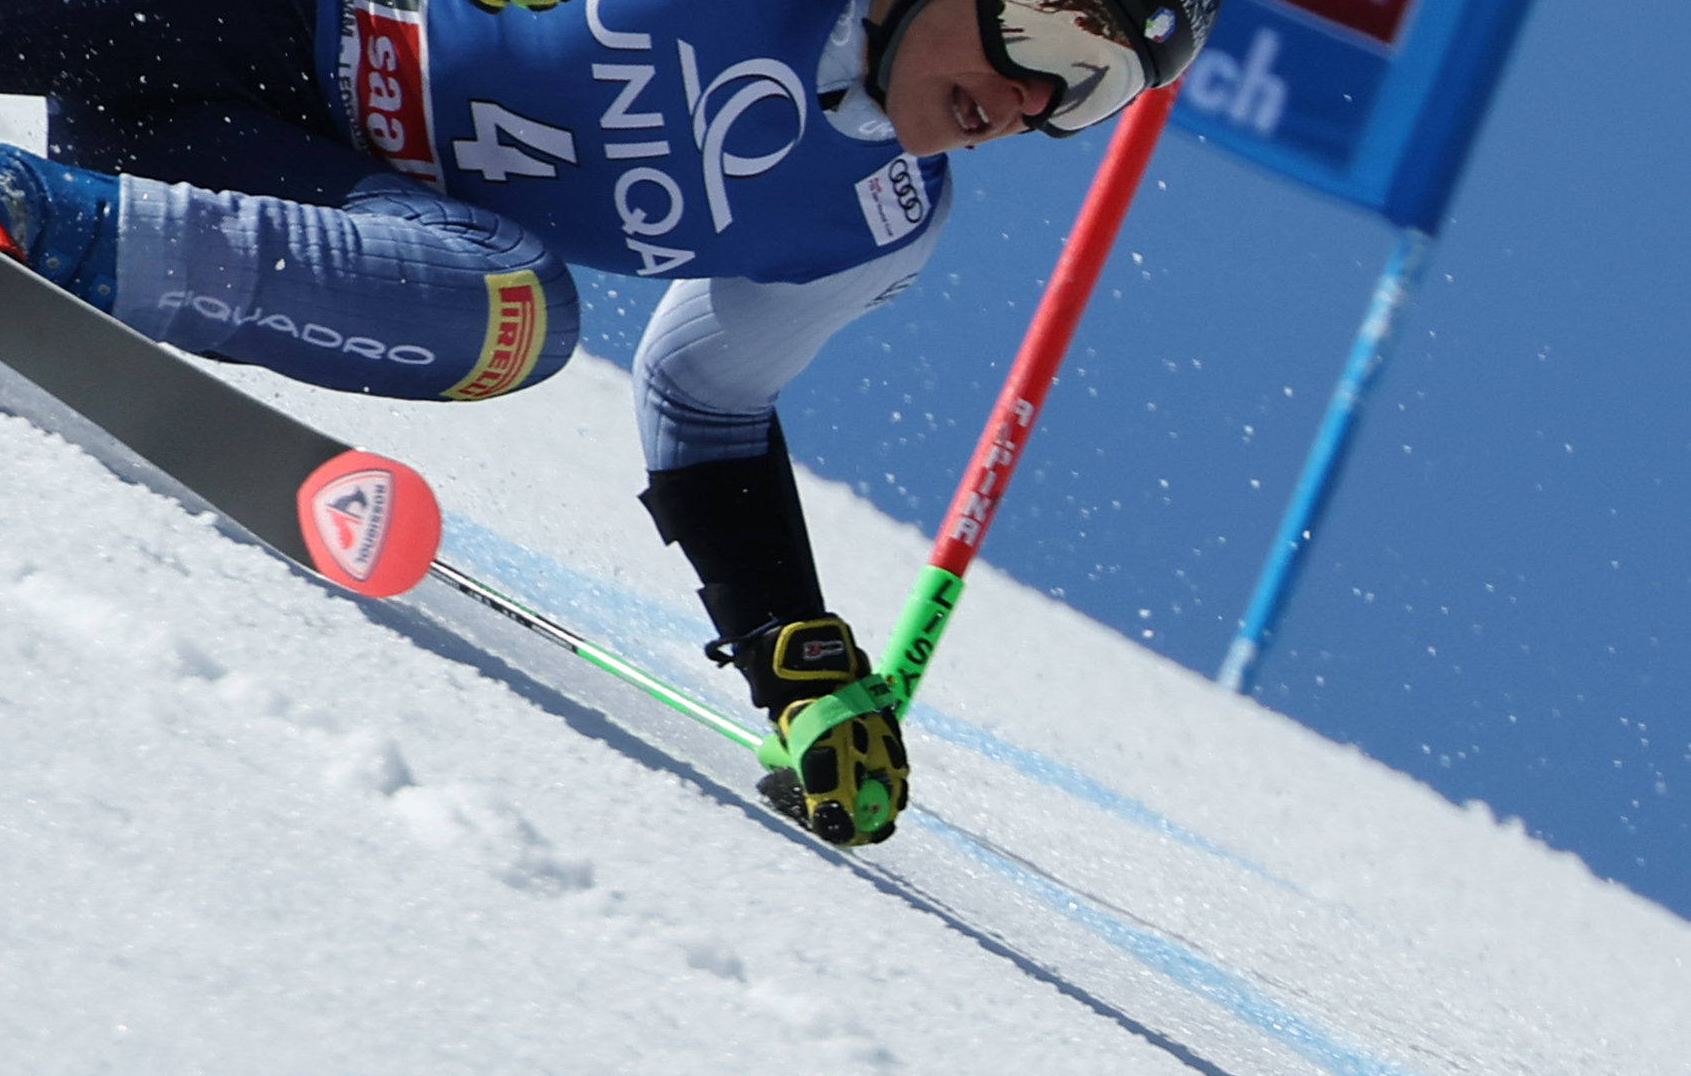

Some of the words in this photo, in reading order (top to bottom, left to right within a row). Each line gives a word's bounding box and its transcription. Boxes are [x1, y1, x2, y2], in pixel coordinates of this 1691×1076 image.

[452, 100, 579, 182] 4
[457, 284, 536, 398] PIRELLI
[354, 484, 386, 564] ROSSIGNOL
